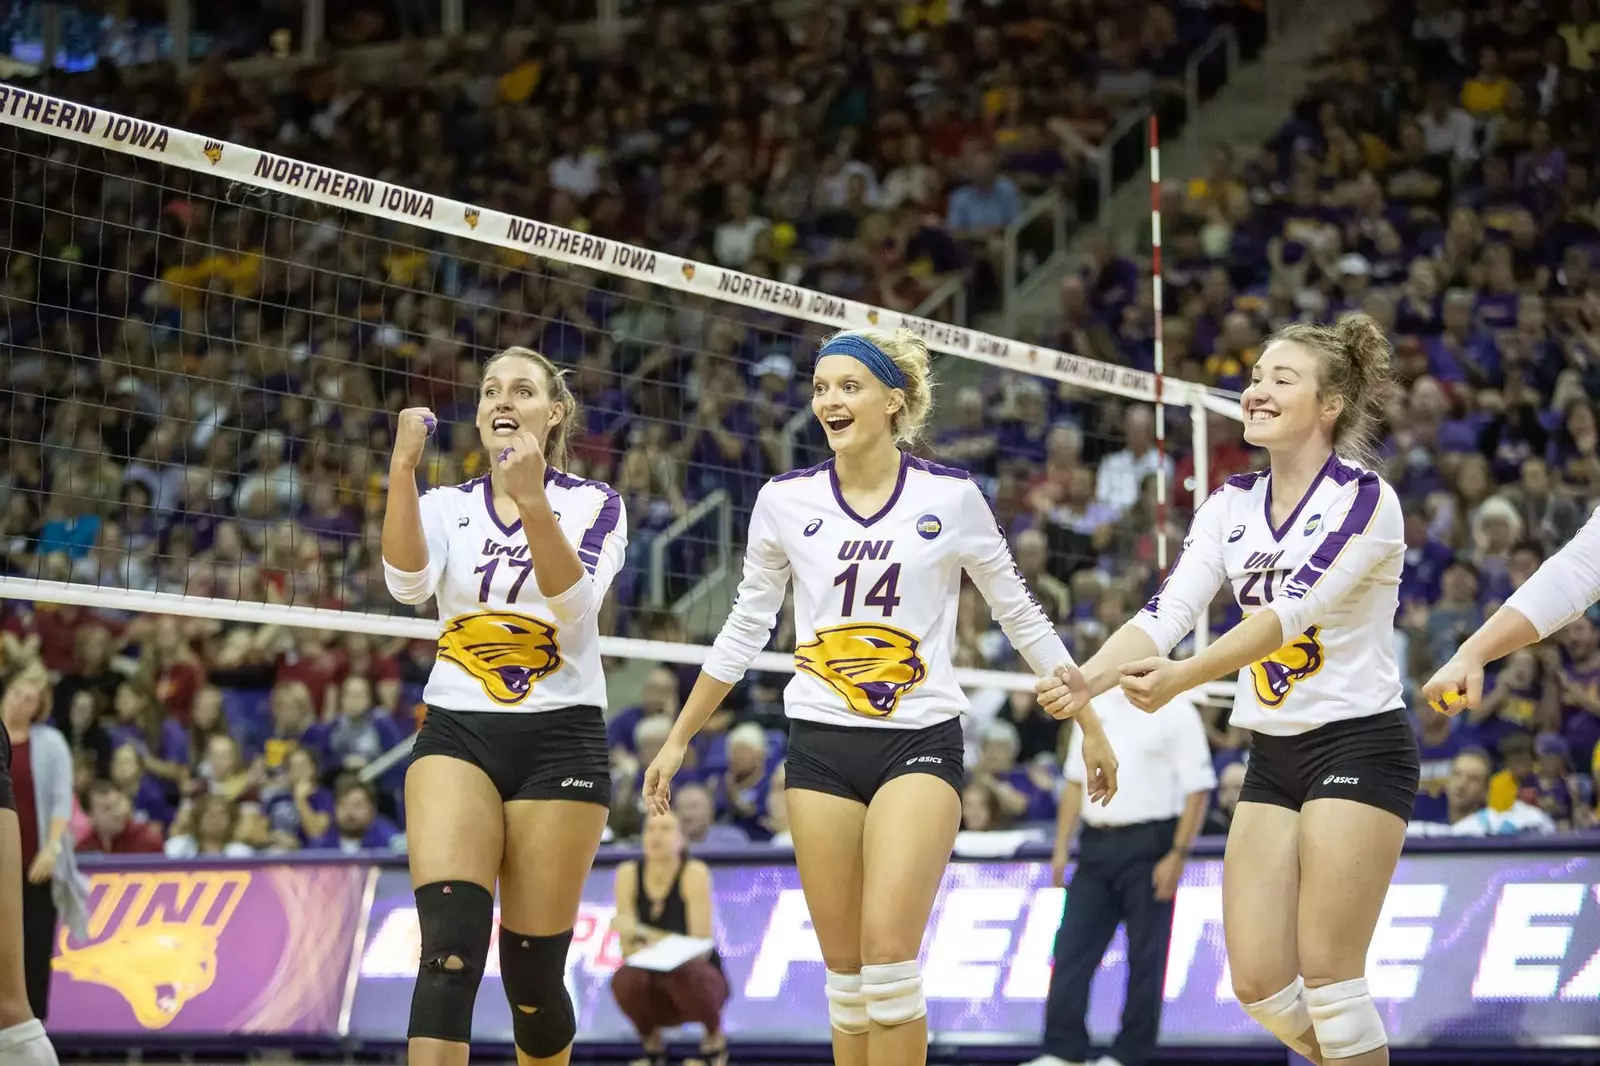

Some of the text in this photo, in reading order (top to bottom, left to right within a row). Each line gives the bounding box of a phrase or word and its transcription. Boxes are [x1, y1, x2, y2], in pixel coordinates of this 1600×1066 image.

[102, 115, 169, 152] IOWA
[204, 140, 224, 151] UNI
[253, 154, 435, 219] NORTHERN IOWA
[506, 218, 657, 273] NORTHERN IOWA
[718, 272, 846, 318] NORTHERN IOWA
[482, 538, 529, 558] UNI
[837, 540, 894, 561] UNI
[1243, 549, 1285, 569] UNI
[473, 557, 533, 604] 17
[833, 563, 902, 617] 14
[60, 871, 252, 941] UNI
